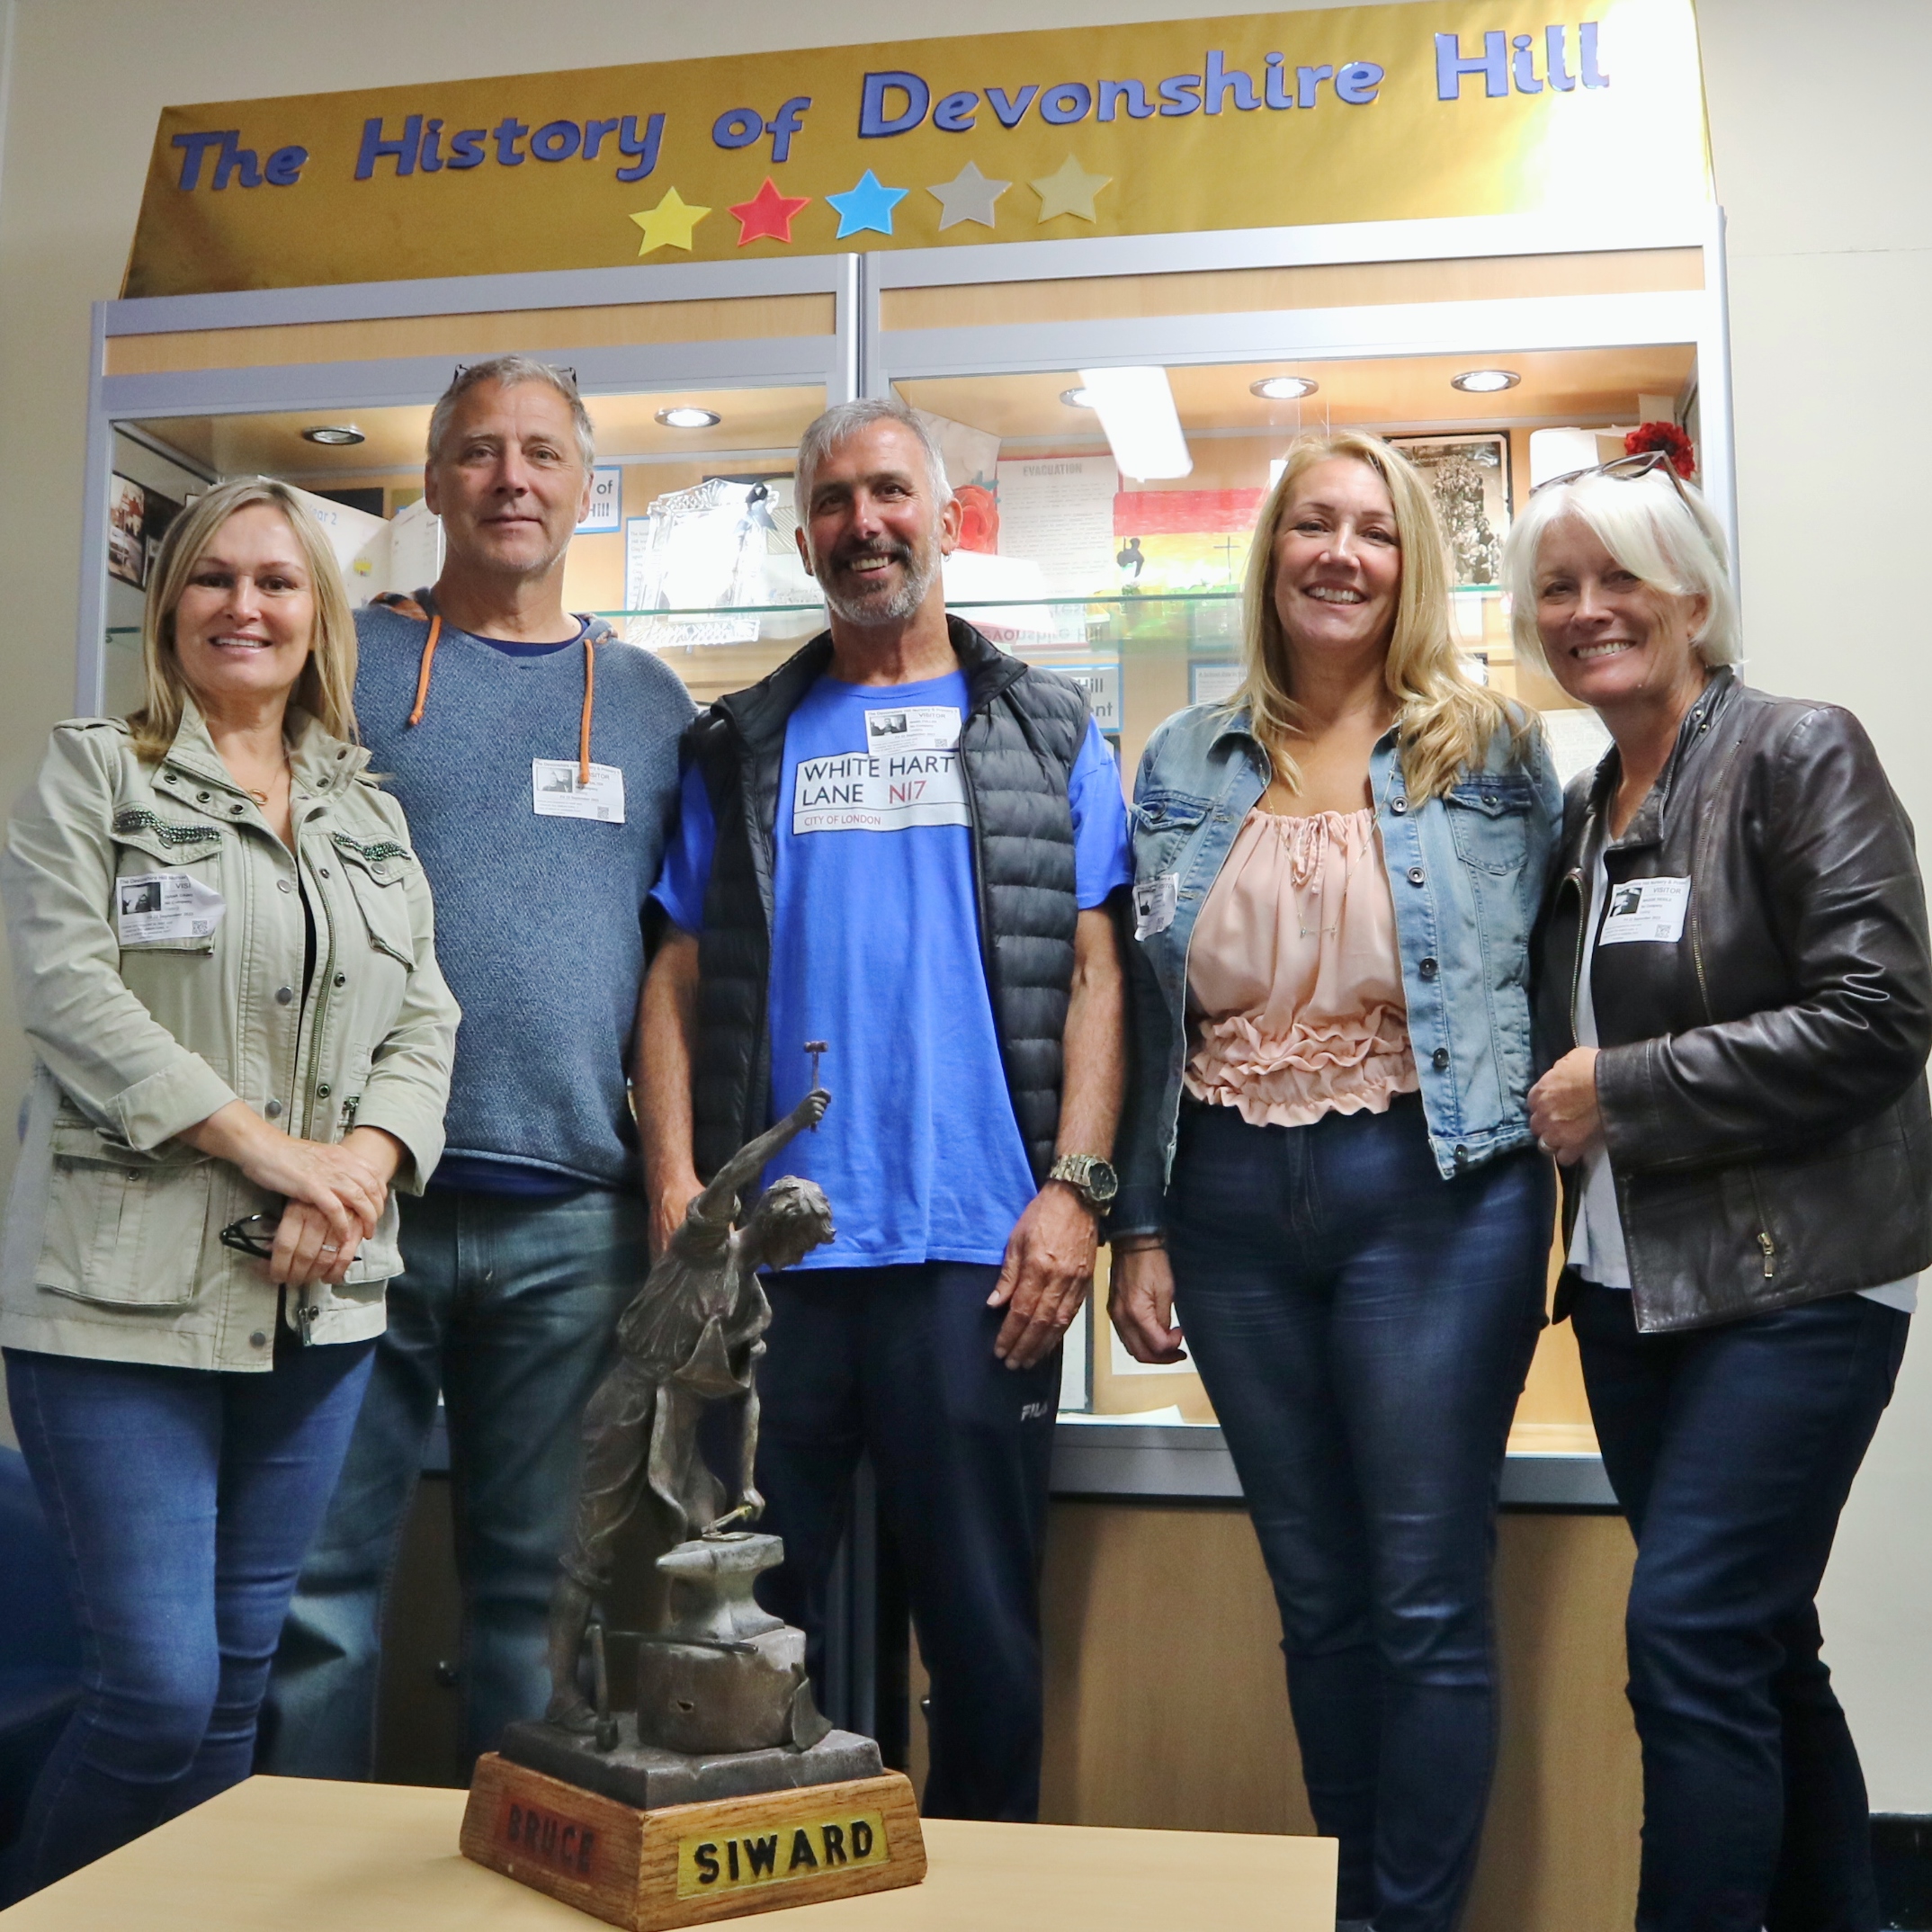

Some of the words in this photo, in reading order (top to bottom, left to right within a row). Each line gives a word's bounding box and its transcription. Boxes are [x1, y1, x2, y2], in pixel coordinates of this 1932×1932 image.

[172, 130, 309, 192] The
[354, 112, 666, 183] History
[711, 96, 811, 163] of
[857, 49, 1384, 139] Devonshire
[1435, 21, 1611, 102] Hill
[1023, 463, 1083, 477] EVACUATION
[596, 479, 613, 494] of
[331, 512, 337, 525] 2
[804, 758, 880, 782] WHITE
[890, 756, 954, 777] HART
[802, 783, 863, 806] LANE
[804, 815, 824, 826] CITY
[827, 815, 839, 825] OF
[841, 814, 881, 826] LONDON
[506, 1802, 595, 1874] BRUCE
[693, 1820, 874, 1885] SIWARD
